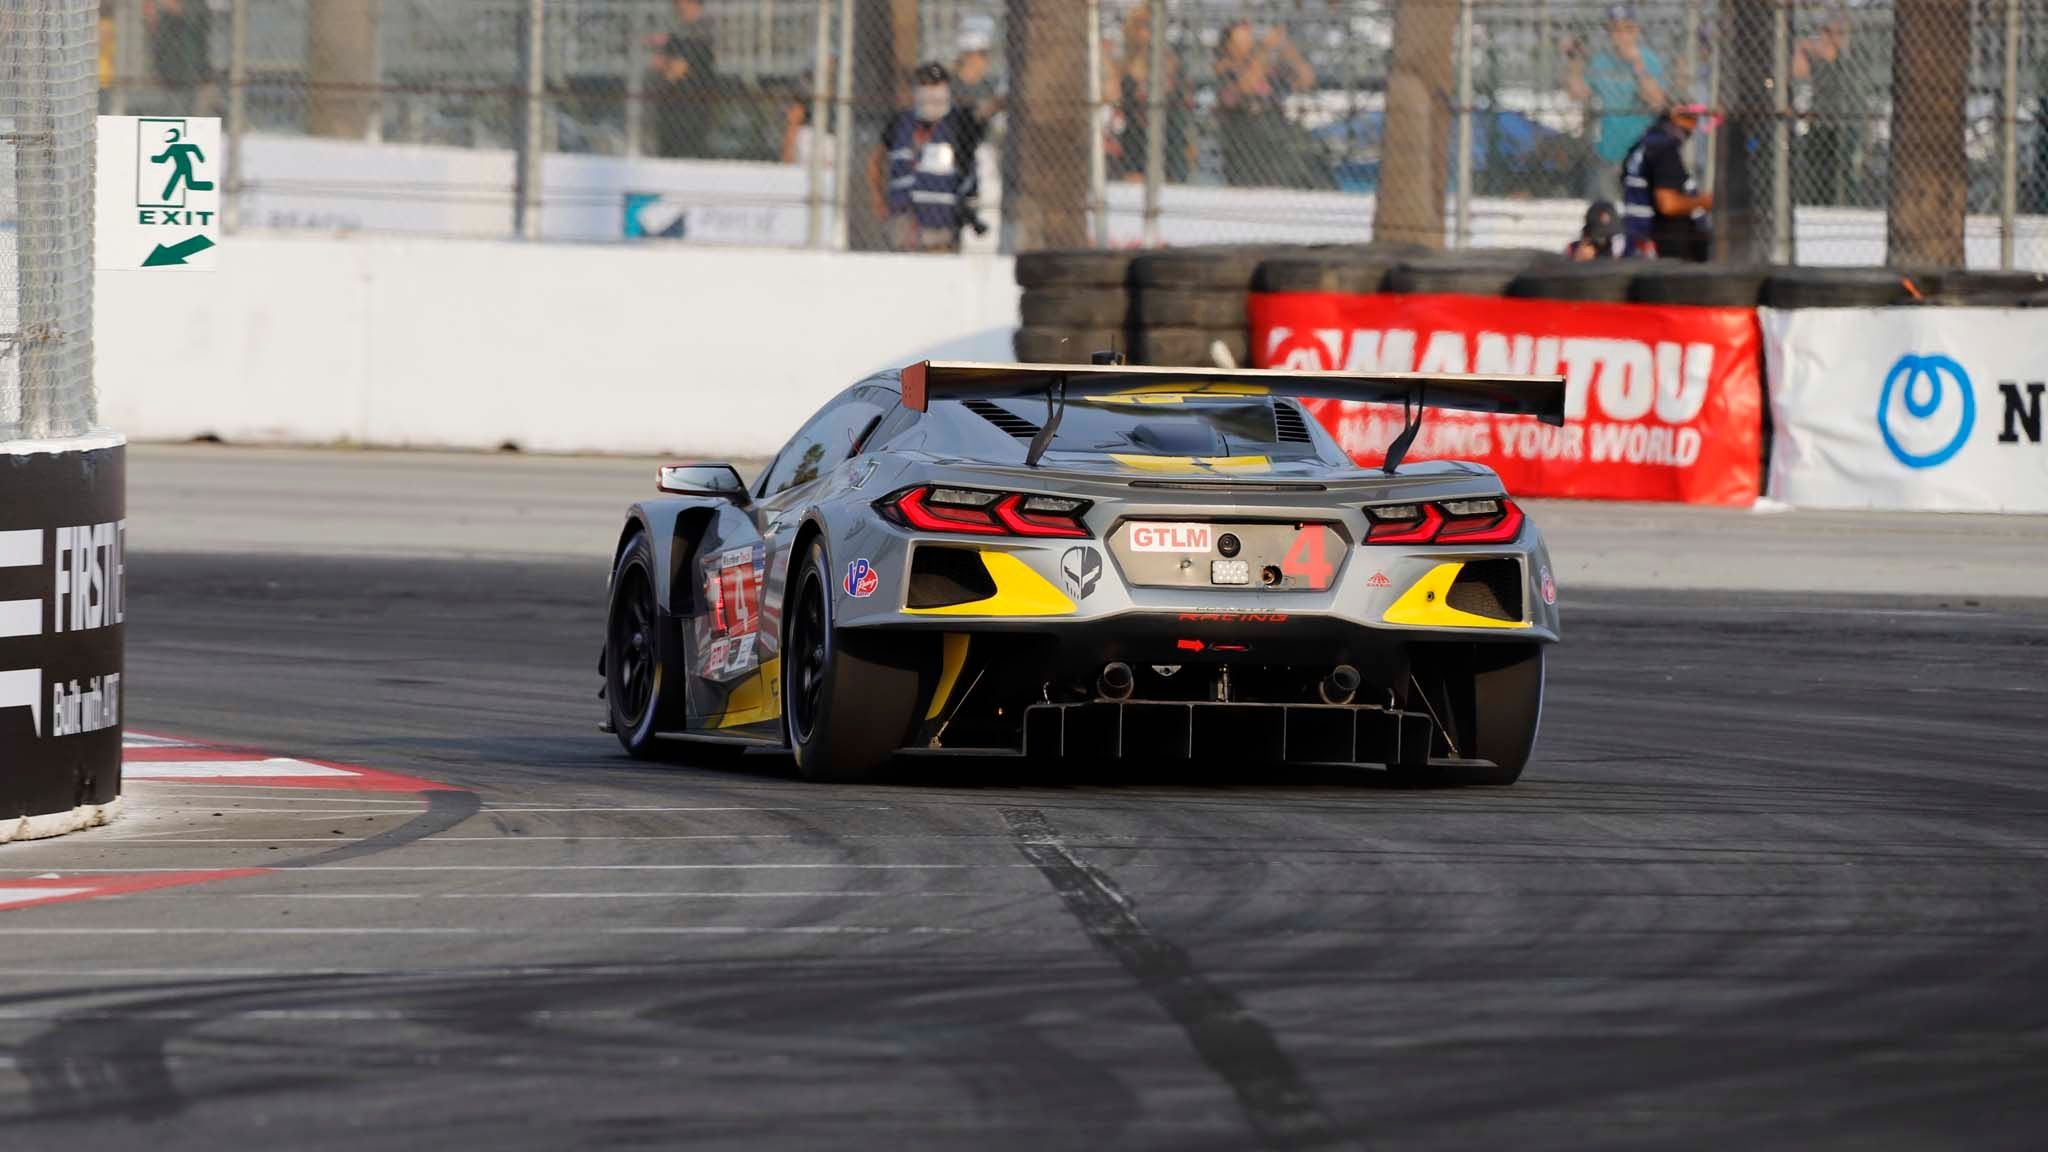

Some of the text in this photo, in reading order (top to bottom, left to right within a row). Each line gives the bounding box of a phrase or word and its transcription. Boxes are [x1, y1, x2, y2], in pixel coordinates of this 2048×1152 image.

[139, 210, 215, 226] EXIT
[1998, 383, 2046, 442] N
[1498, 421, 1585, 461] YOUR
[1589, 423, 1702, 468] WORLD
[1134, 528, 1208, 548] GTLM
[1282, 523, 1334, 592] 4
[847, 558, 869, 597] VP
[735, 568, 749, 633] 4
[1177, 613, 1289, 623] RACING
